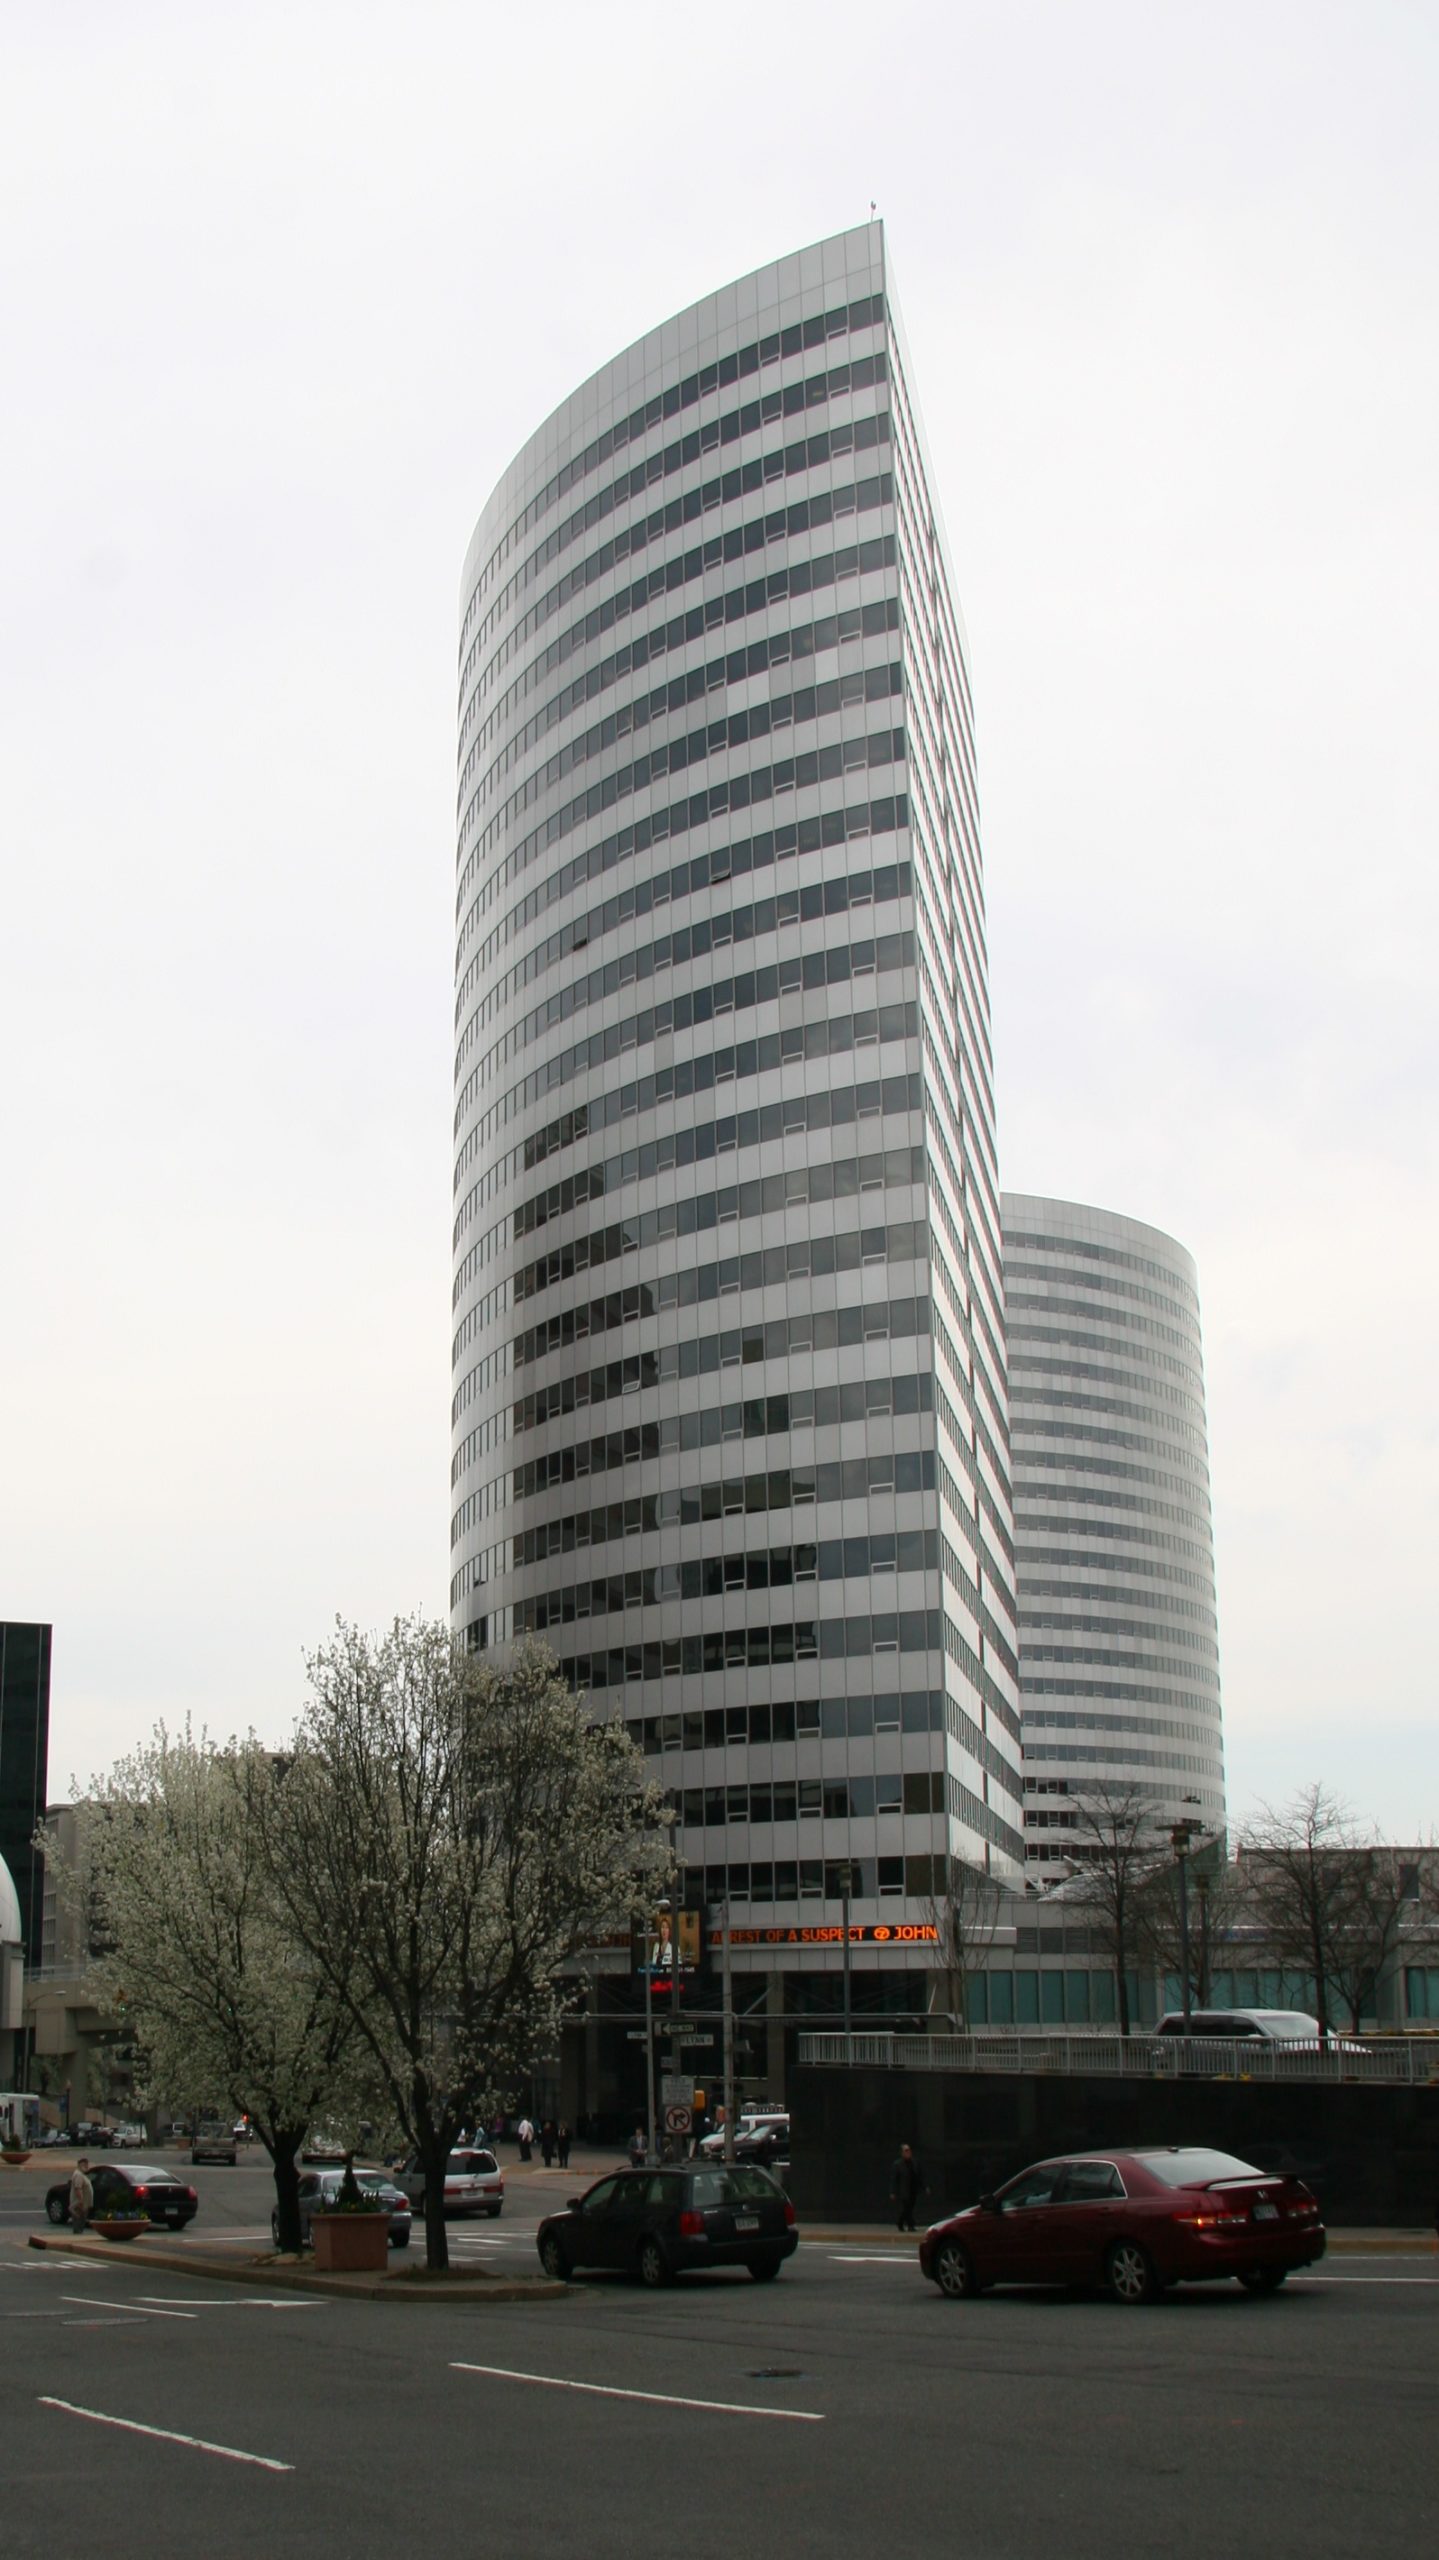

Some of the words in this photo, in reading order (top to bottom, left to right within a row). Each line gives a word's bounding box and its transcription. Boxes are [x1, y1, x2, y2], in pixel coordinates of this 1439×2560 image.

[712, 1930, 761, 1944] AREST
[767, 1930, 785, 1943] OF
[788, 1929, 798, 1942] A
[801, 1927, 865, 1942] SUSPECT
[894, 1926, 937, 1940] JOHN
